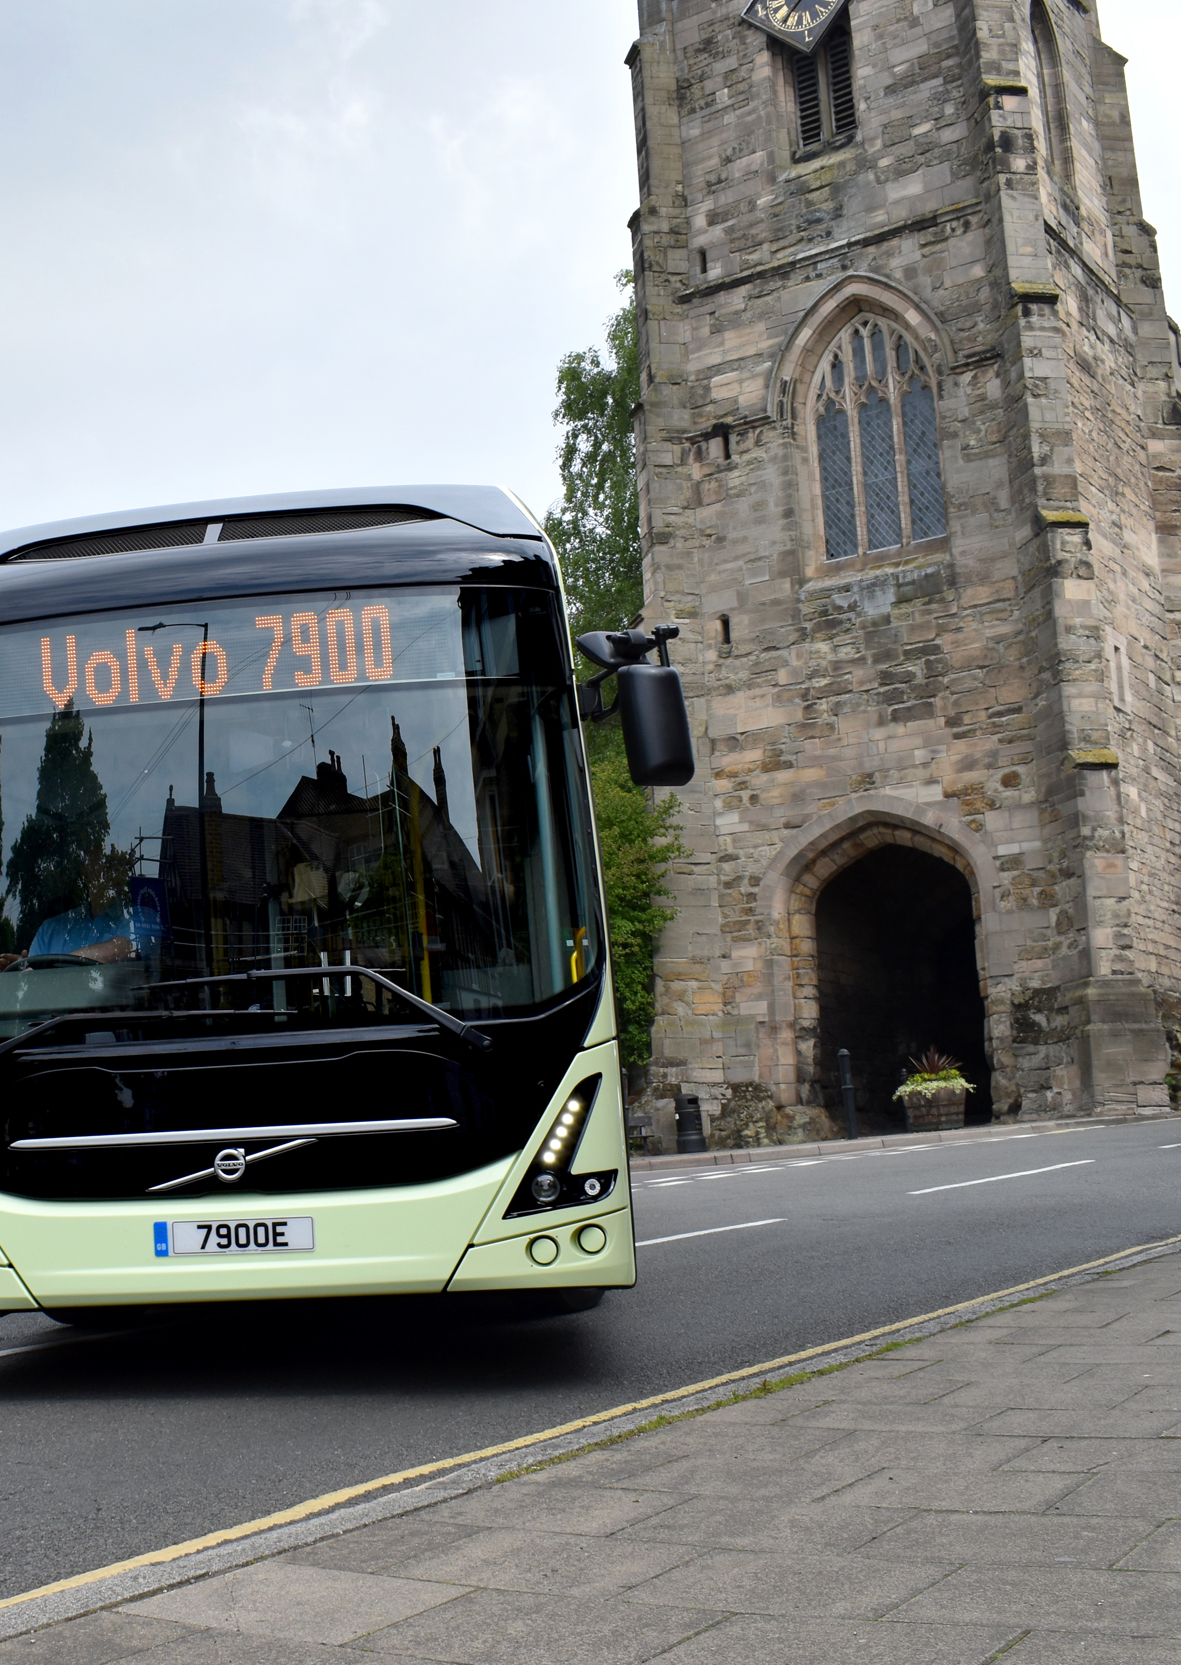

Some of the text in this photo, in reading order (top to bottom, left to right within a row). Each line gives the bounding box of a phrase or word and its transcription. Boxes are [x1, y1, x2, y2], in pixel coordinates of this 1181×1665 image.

[41, 605, 393, 708] Volvo 7900
[197, 1221, 288, 1250] 7900E
